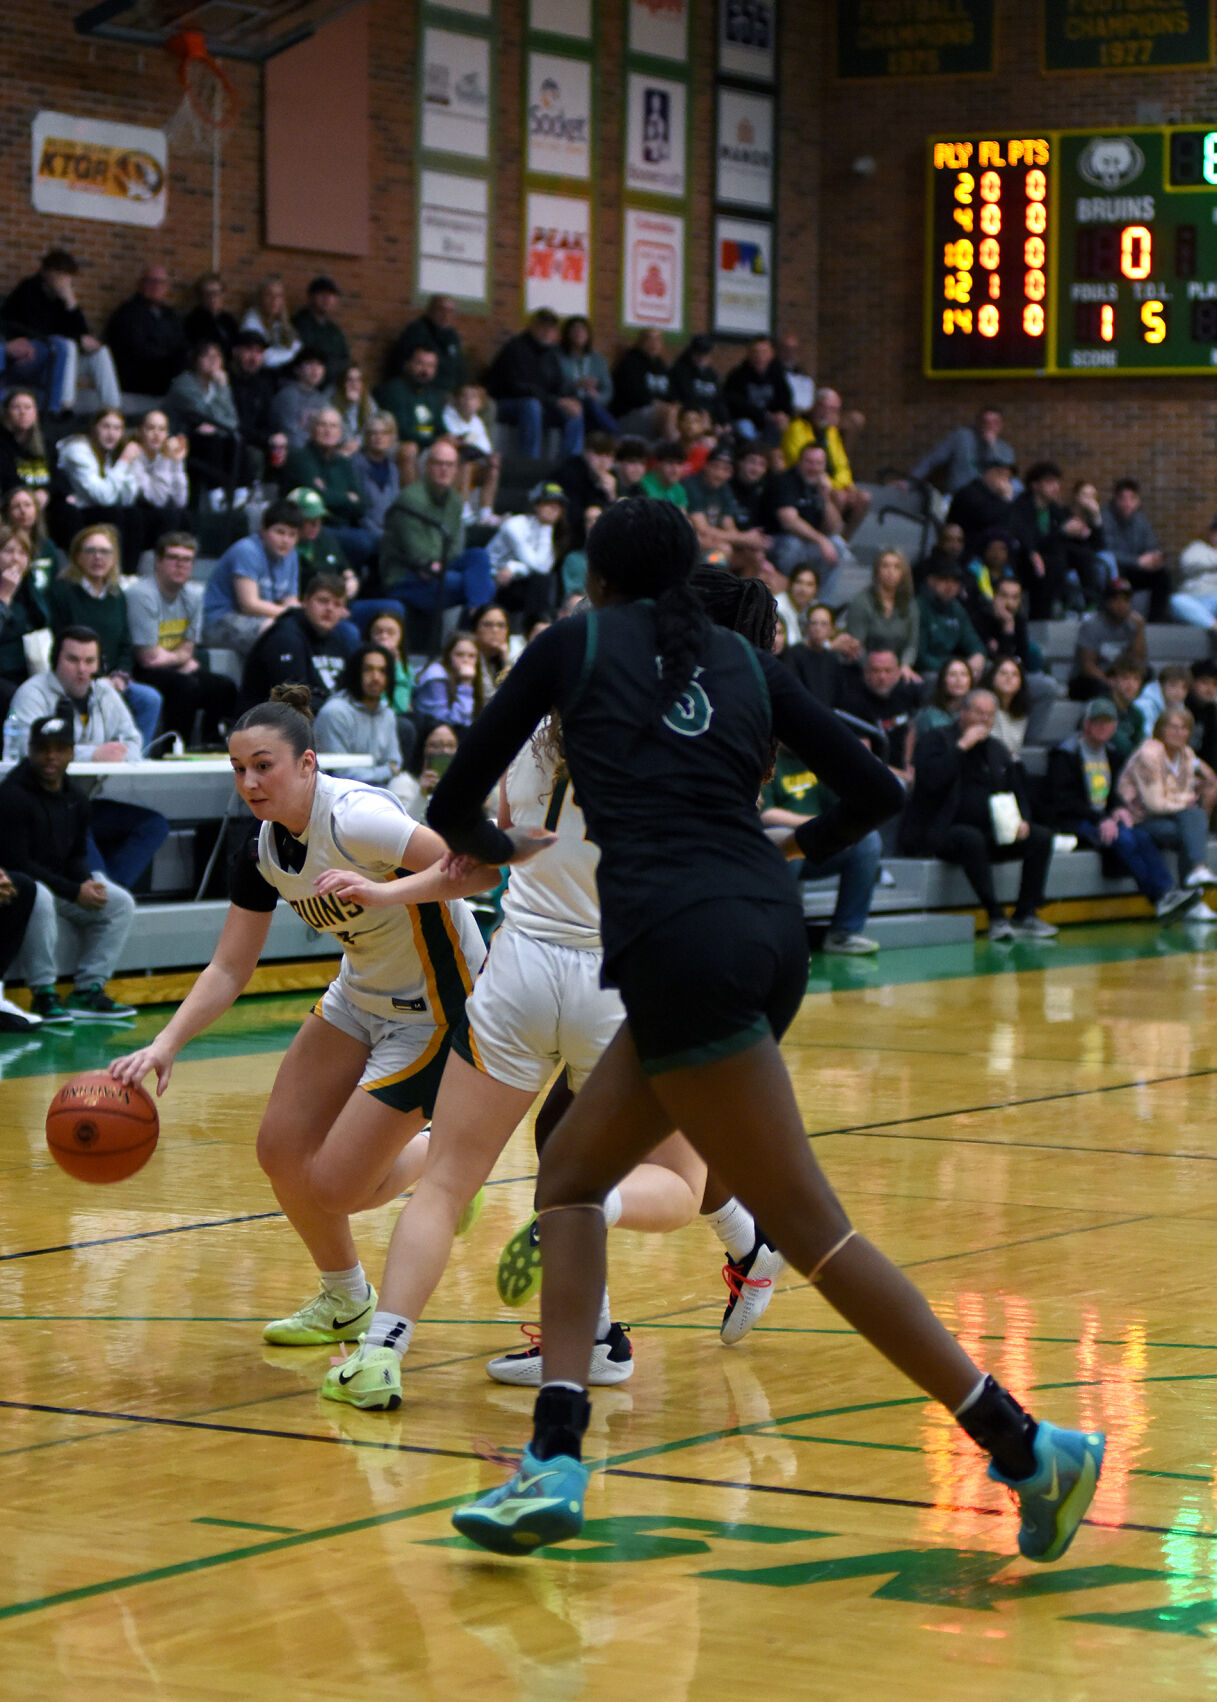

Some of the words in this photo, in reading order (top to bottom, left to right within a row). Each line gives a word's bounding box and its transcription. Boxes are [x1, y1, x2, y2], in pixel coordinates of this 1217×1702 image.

[1064, 10, 1190, 40] CHAMPIONS
[1099, 40, 1154, 65] 1977
[1008, 139, 1049, 166] PTS
[954, 172, 975, 204] 2
[980, 171, 1001, 203] 0
[1025, 169, 1046, 201] 0
[953, 207, 974, 233] 4
[980, 203, 1002, 236] 0
[1025, 201, 1047, 235] 0
[1076, 195, 1155, 222] BRUINS
[979, 237, 1000, 271] 0
[1024, 235, 1045, 269] 0
[1120, 225, 1152, 280] 0
[988, 272, 1000, 300] 1
[1024, 269, 1045, 302] 0
[1071, 282, 1119, 302] FOULS
[978, 303, 999, 338] 0
[1023, 303, 1044, 337] 0
[1100, 304, 1114, 342] 1
[1140, 299, 1167, 344] 5
[1070, 349, 1118, 368] SCORE
